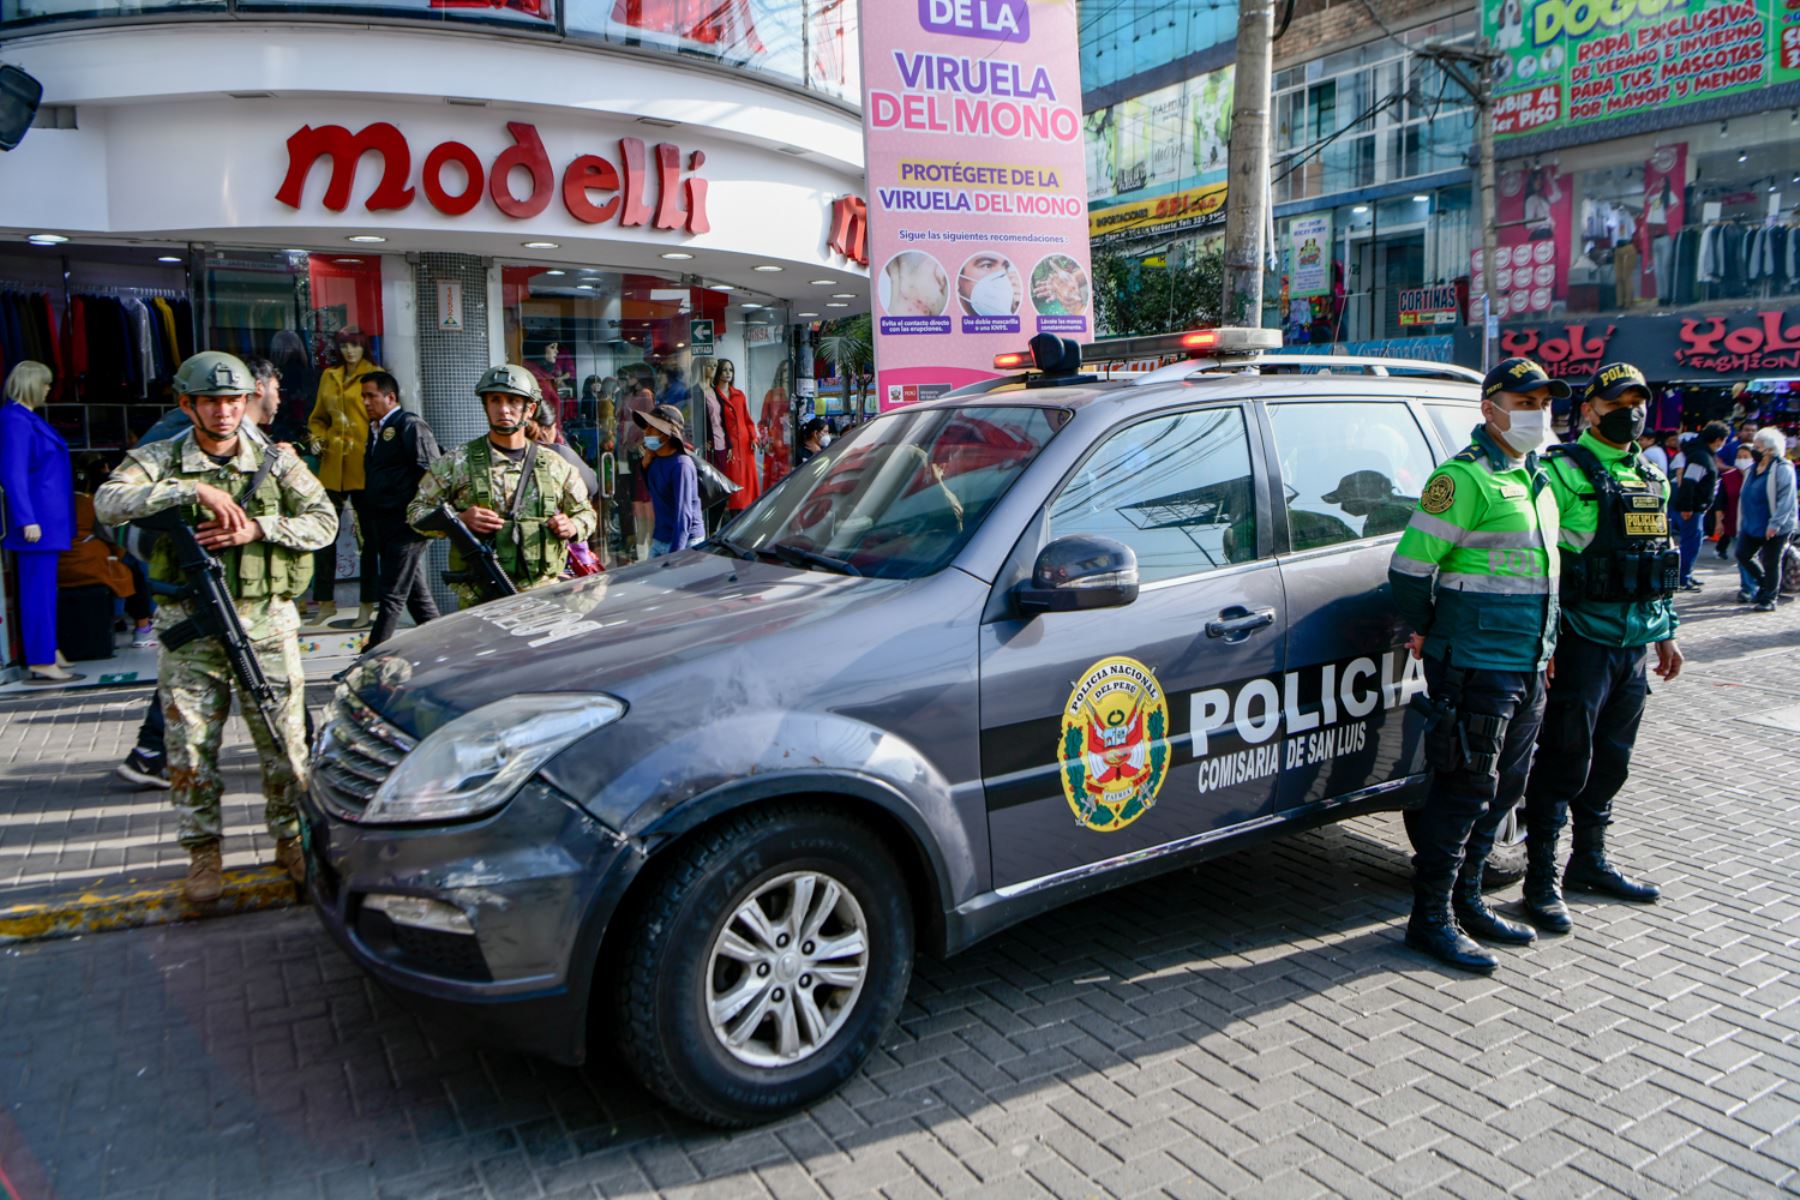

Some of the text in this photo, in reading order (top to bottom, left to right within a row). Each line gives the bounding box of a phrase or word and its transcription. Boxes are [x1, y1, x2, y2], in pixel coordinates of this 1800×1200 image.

[929, 0, 1019, 34] DE LA
[1572, 21, 1763, 80] DE VERANO E INVIERNO
[1578, 33, 1630, 61] ROPA
[895, 52, 1056, 100] VIRUELA
[1571, 78, 1614, 101] PARA
[1621, 69, 1652, 89] TUS
[1661, 41, 1763, 79] MASCOTAS
[1538, 87, 1559, 105] AL
[1570, 65, 1763, 119] POR MAYOR Y MENOR
[871, 92, 1079, 141] DEL MONO
[1519, 105, 1557, 128] PISO
[902, 162, 1059, 187] PROTÉGETE DE LA
[880, 190, 1081, 216] VIRUELA DEL MONO
[899, 230, 925, 241] Sigue
[928, 231, 941, 239] las
[943, 231, 988, 243] siguientes
[990, 233, 1064, 243] recomendaciones
[1400, 287, 1455, 311] CORTINAS
[1072, 665, 1157, 711] POLICIA NACIONAL
[1095, 684, 1112, 698] DEL
[1190, 648, 1430, 757] POLICIA
[1198, 722, 1366, 794] COMISARIA DE SAN LUIS
